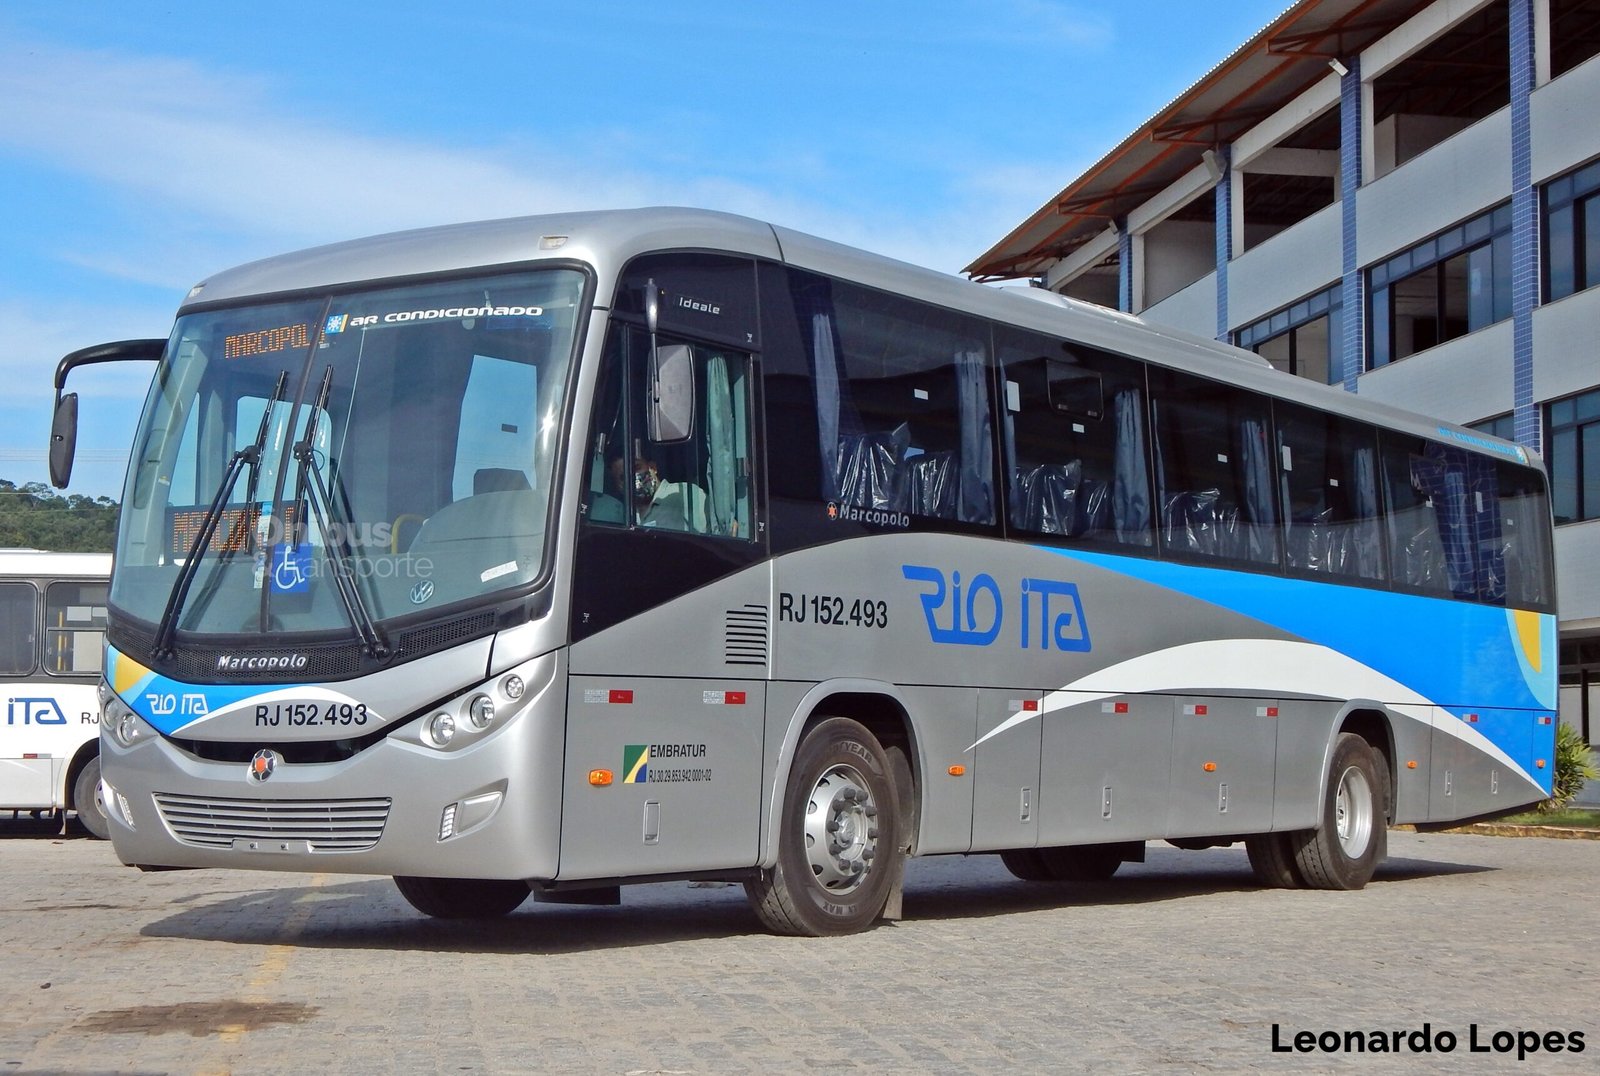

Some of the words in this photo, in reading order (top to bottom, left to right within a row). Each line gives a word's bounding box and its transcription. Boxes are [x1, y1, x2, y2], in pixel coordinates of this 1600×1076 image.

[679, 297, 720, 315] Ideale
[839, 504, 910, 527] Marcopolo
[779, 592, 806, 622] RJ
[811, 595, 888, 628] 152.493
[217, 653, 307, 671] Marcopolo
[255, 705, 281, 727] RJ
[285, 704, 368, 726] 152.493
[650, 744, 707, 758] EMBRATUR
